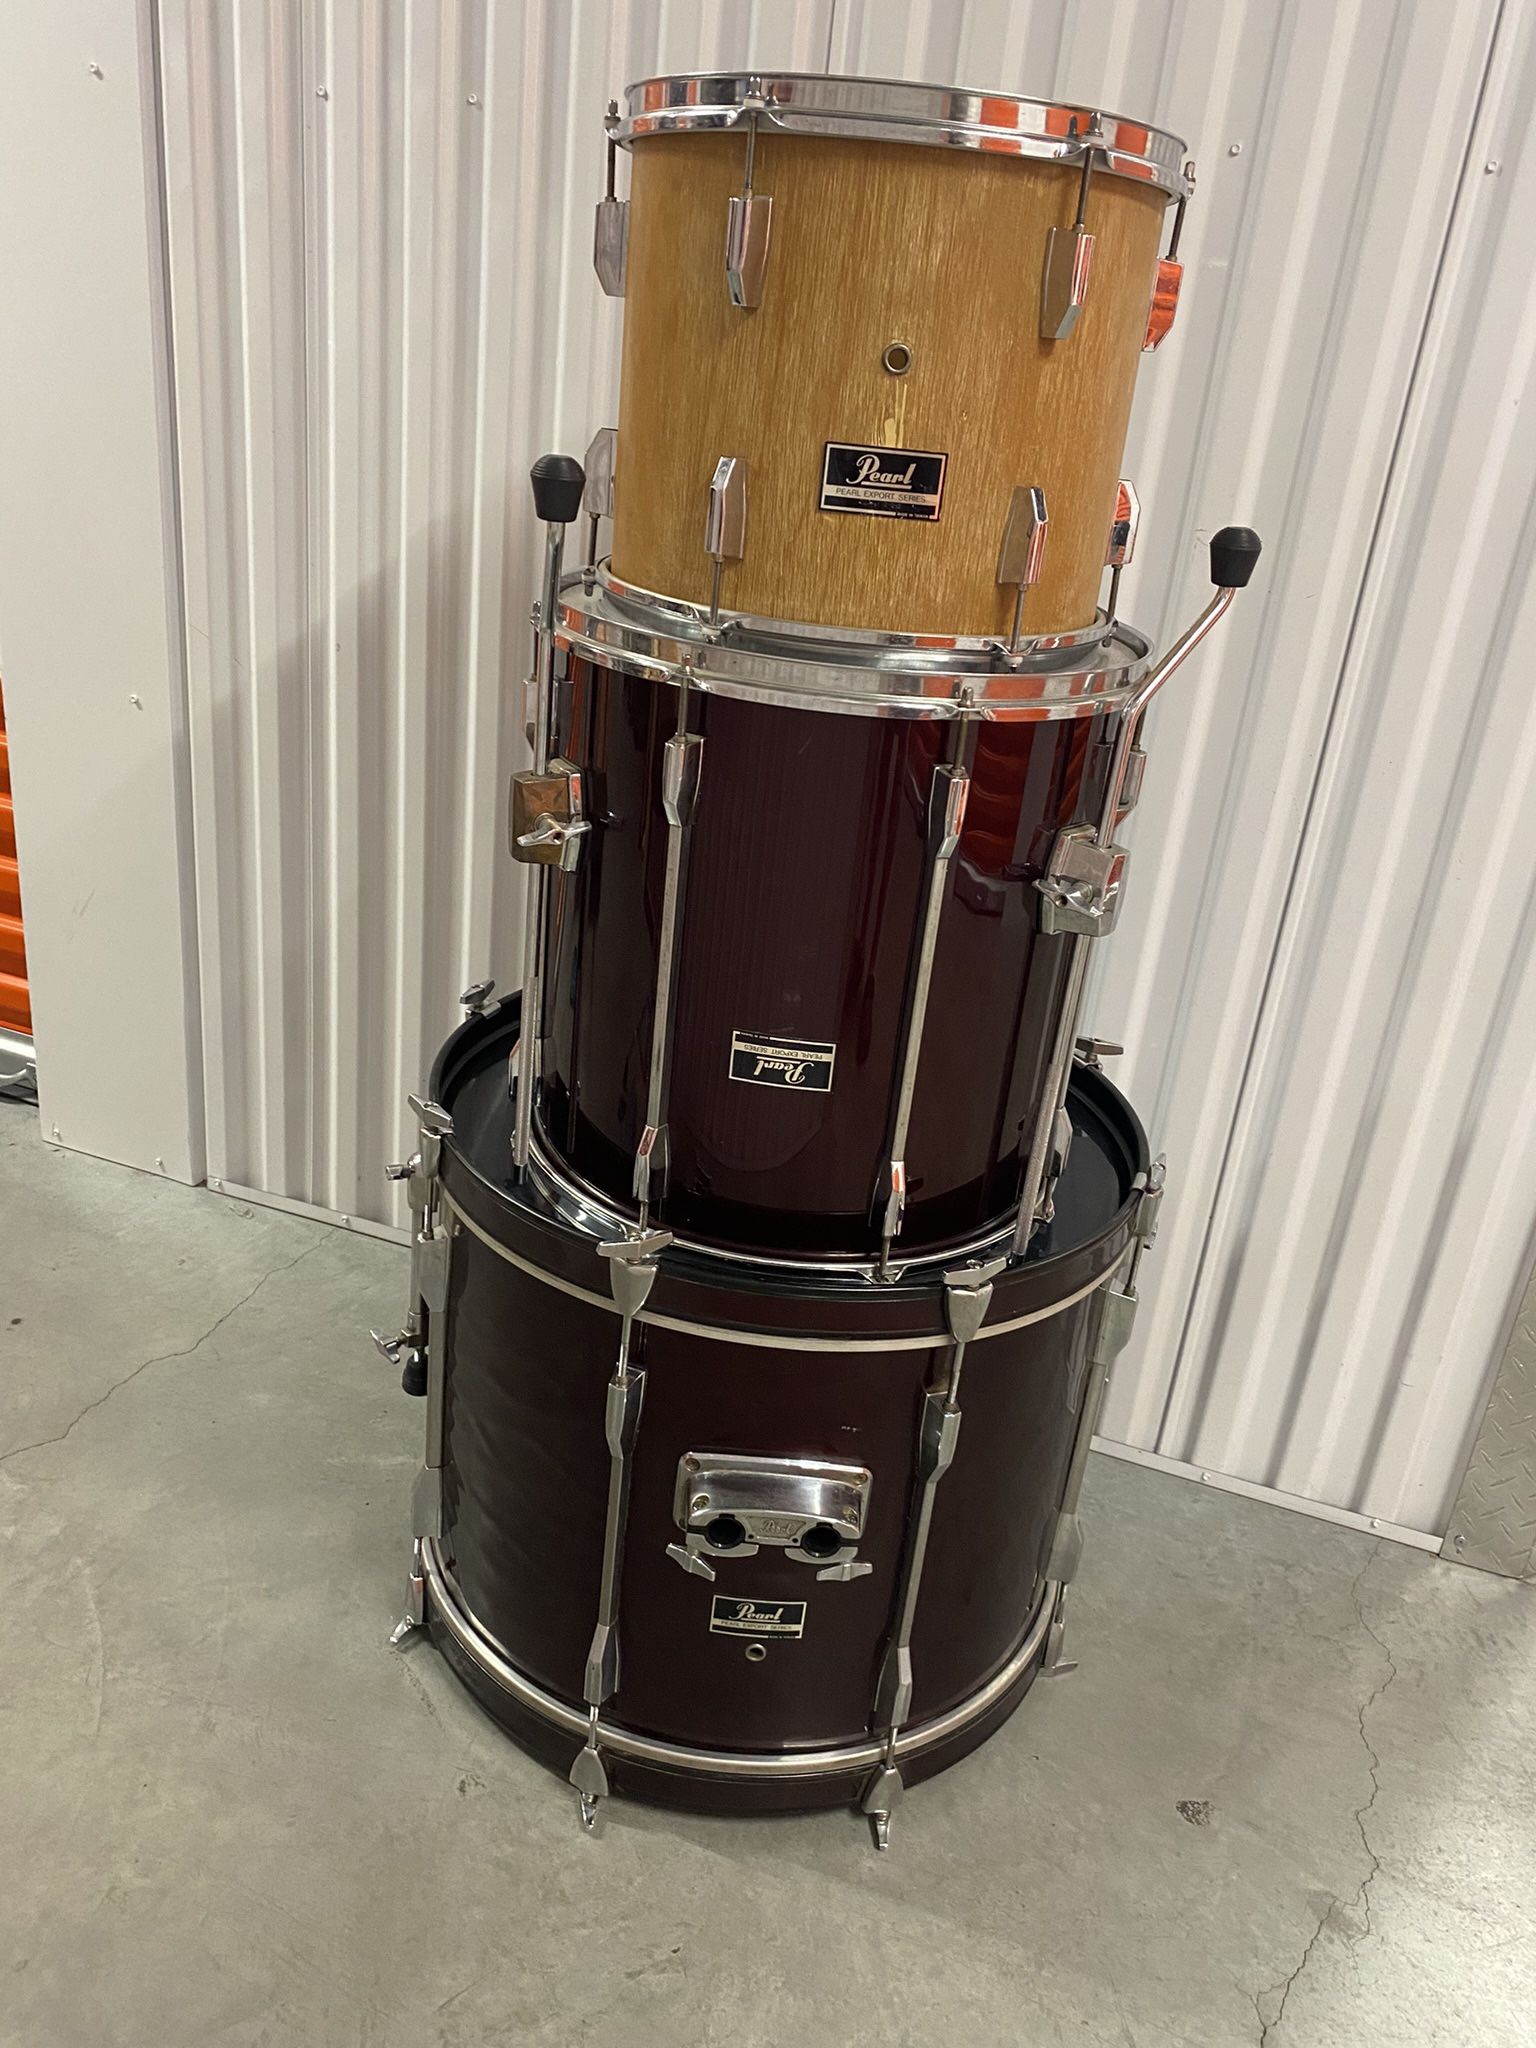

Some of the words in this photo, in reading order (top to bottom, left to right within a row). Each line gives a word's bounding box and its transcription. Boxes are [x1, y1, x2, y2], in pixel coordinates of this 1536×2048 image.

[845, 454, 917, 486] Pearl
[835, 488, 861, 497] PEARL
[863, 490, 895, 500] EXPORT
[897, 494, 927, 503] SERIES
[771, 1049, 799, 1057] EXPORT
[753, 1060, 815, 1084] Pearl
[728, 1602, 784, 1620] Pearl
